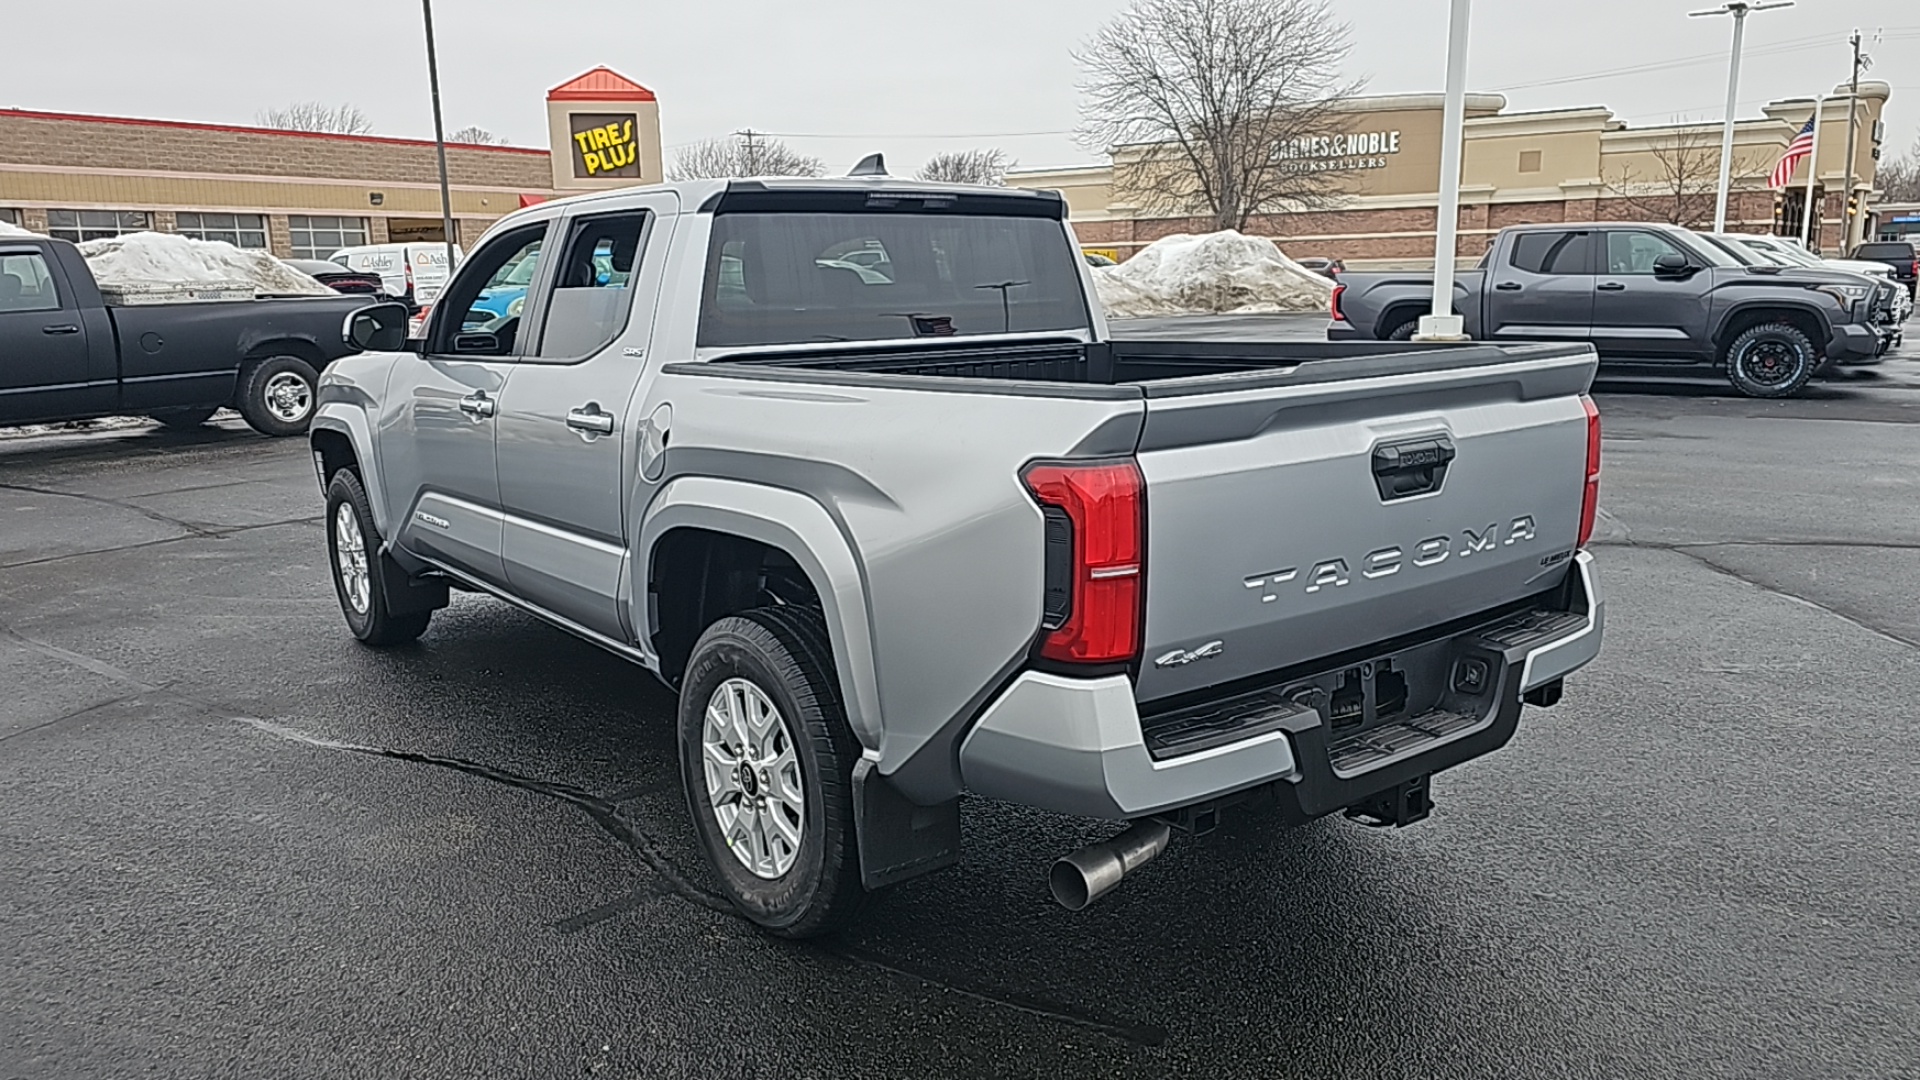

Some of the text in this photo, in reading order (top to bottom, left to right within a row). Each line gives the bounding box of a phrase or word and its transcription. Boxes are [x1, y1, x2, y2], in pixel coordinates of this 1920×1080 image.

[574, 119, 632, 153] TIRES
[584, 141, 636, 174] PLUS
[370, 255, 394, 269] Ashley
[1400, 449, 1437, 468] TOYOTA
[1243, 514, 1535, 602] TACOMA
